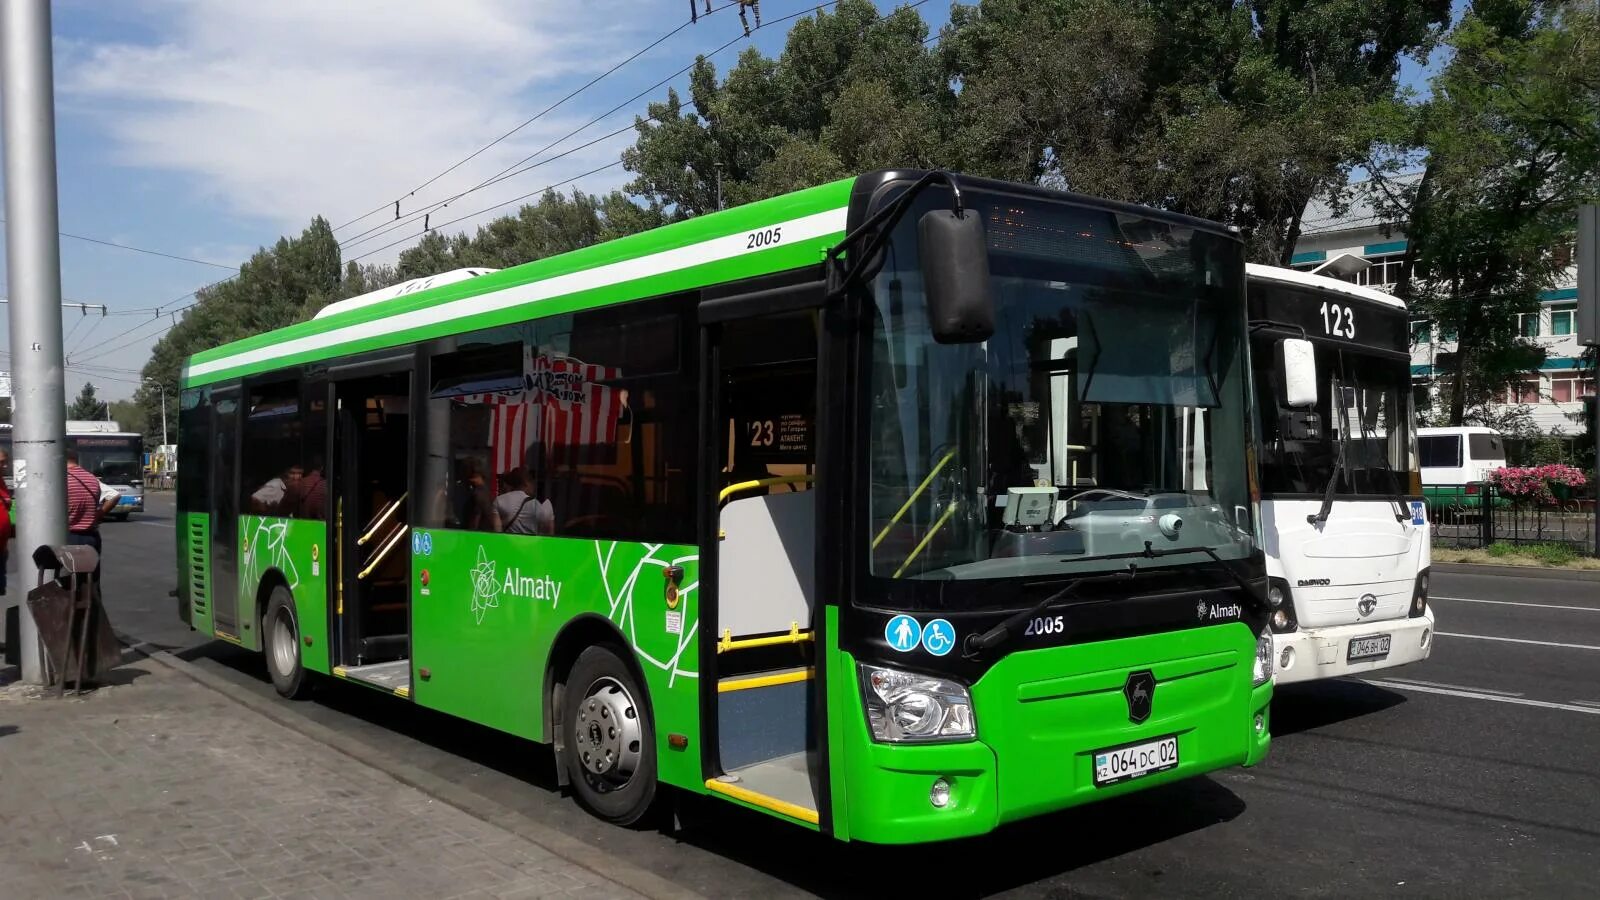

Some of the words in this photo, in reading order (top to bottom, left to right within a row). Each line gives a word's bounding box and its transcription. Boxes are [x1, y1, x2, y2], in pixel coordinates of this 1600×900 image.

[746, 227, 782, 249] 2005
[1320, 301, 1355, 339] 123
[503, 567, 562, 609] Almaty
[1297, 578, 1330, 587] DAEWOO
[1209, 603, 1242, 620] Almaty
[1024, 615, 1064, 636] 2005
[1097, 767, 1108, 778] KZ
[1111, 750, 1137, 774] 064
[1140, 750, 1156, 768] DC
[1160, 741, 1175, 762] 02
